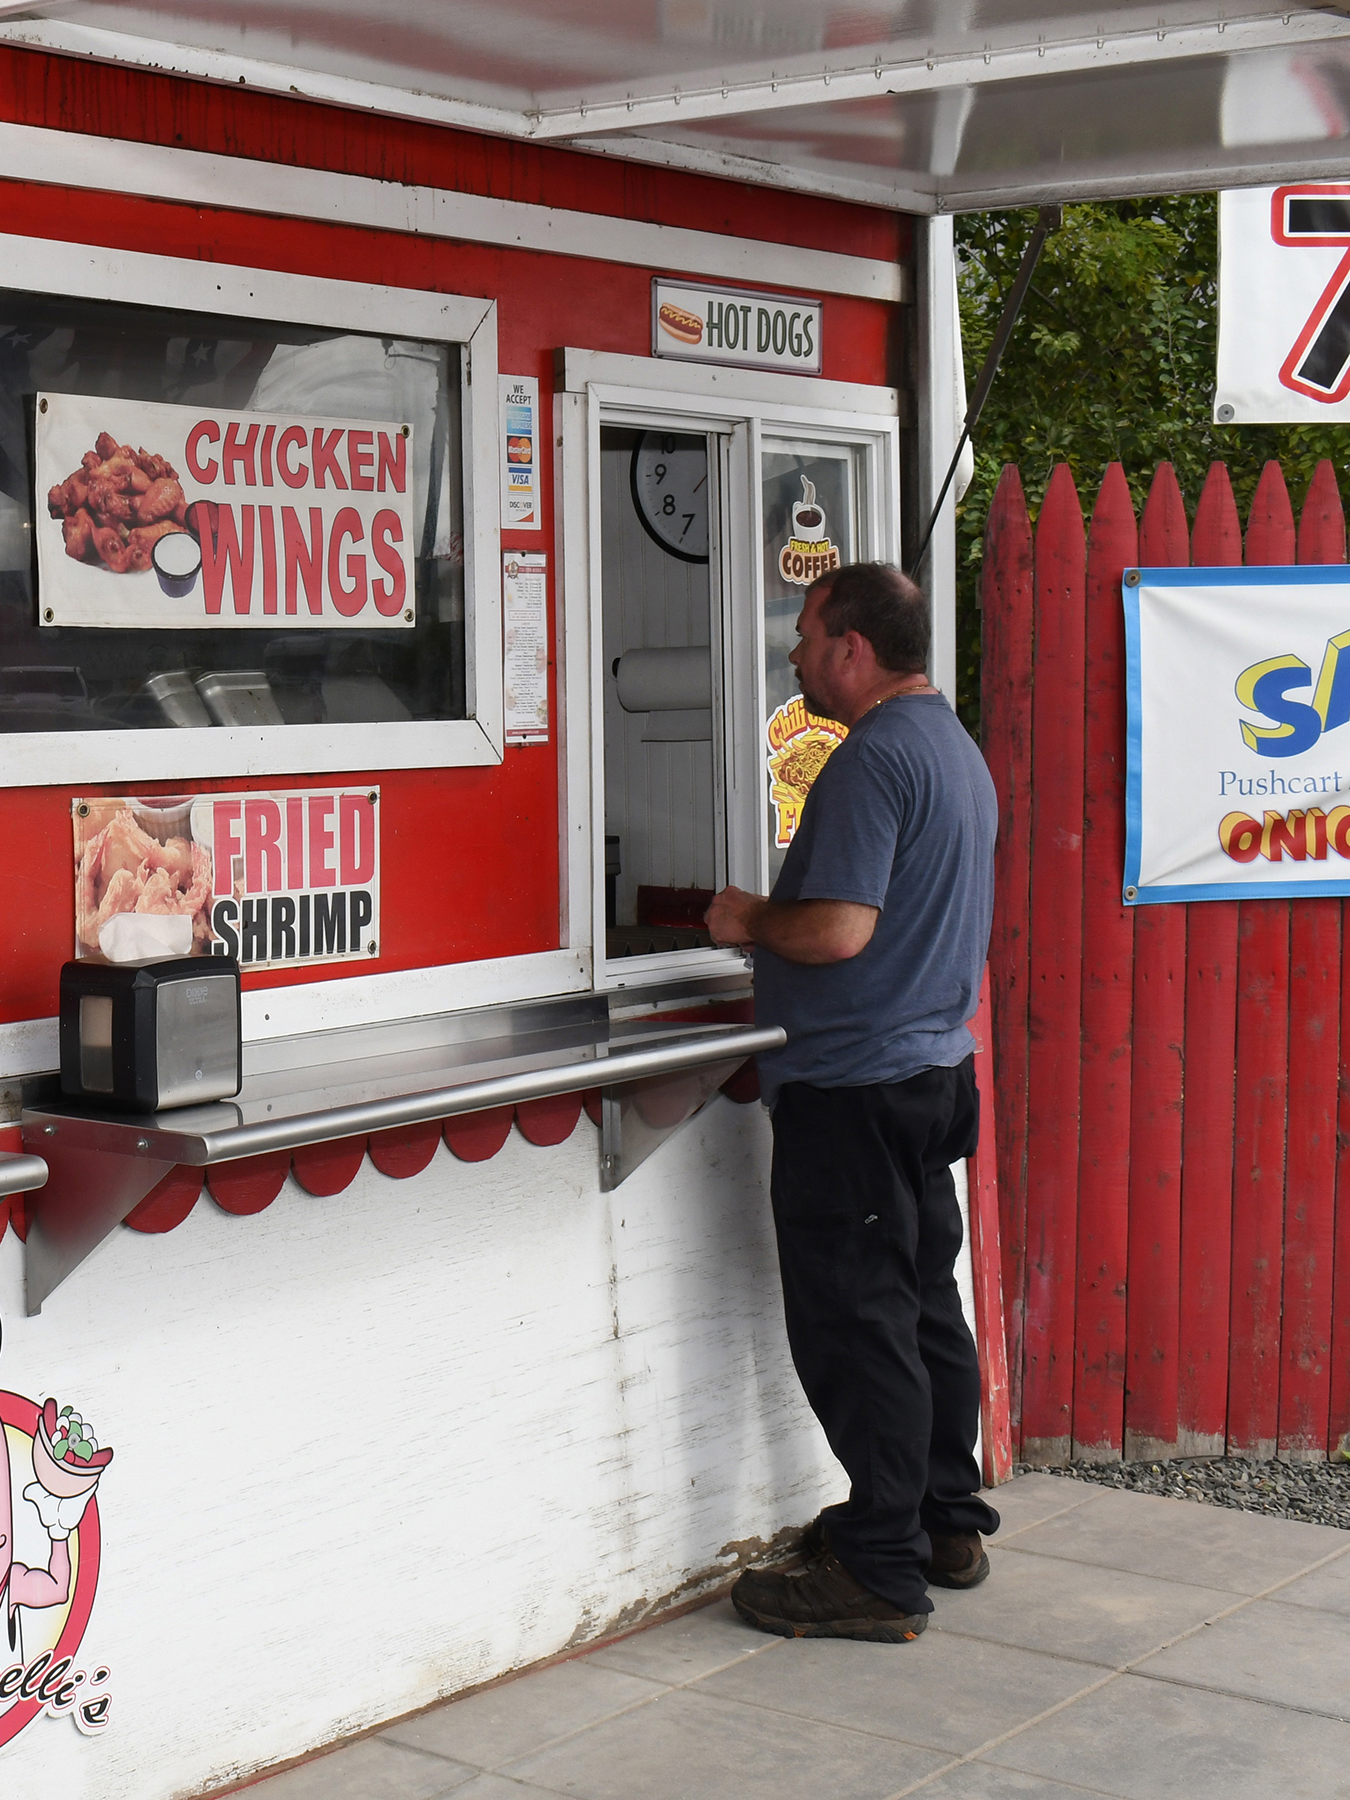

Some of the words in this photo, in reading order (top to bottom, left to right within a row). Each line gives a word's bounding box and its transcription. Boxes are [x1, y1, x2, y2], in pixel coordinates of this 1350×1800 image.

[706, 301, 751, 350] HOT
[757, 307, 813, 358] DOGS
[506, 394, 531, 405] ACCEPT
[513, 385, 524, 394] WE
[185, 420, 406, 493] CHICKEN
[512, 475, 529, 485] VISA
[655, 464, 667, 485] 9
[510, 501, 532, 509] DISCOVER
[663, 494, 676, 515] 8
[682, 513, 695, 535] 7
[791, 540, 809, 553] FRESH
[817, 540, 829, 552] HOT
[195, 503, 406, 617] WINGS
[783, 551, 837, 578] COFFEE
[768, 699, 807, 749] Chili
[1218, 770, 1342, 796] Pushcart
[213, 795, 375, 895] FRIED
[213, 890, 372, 963] SHRIMP
